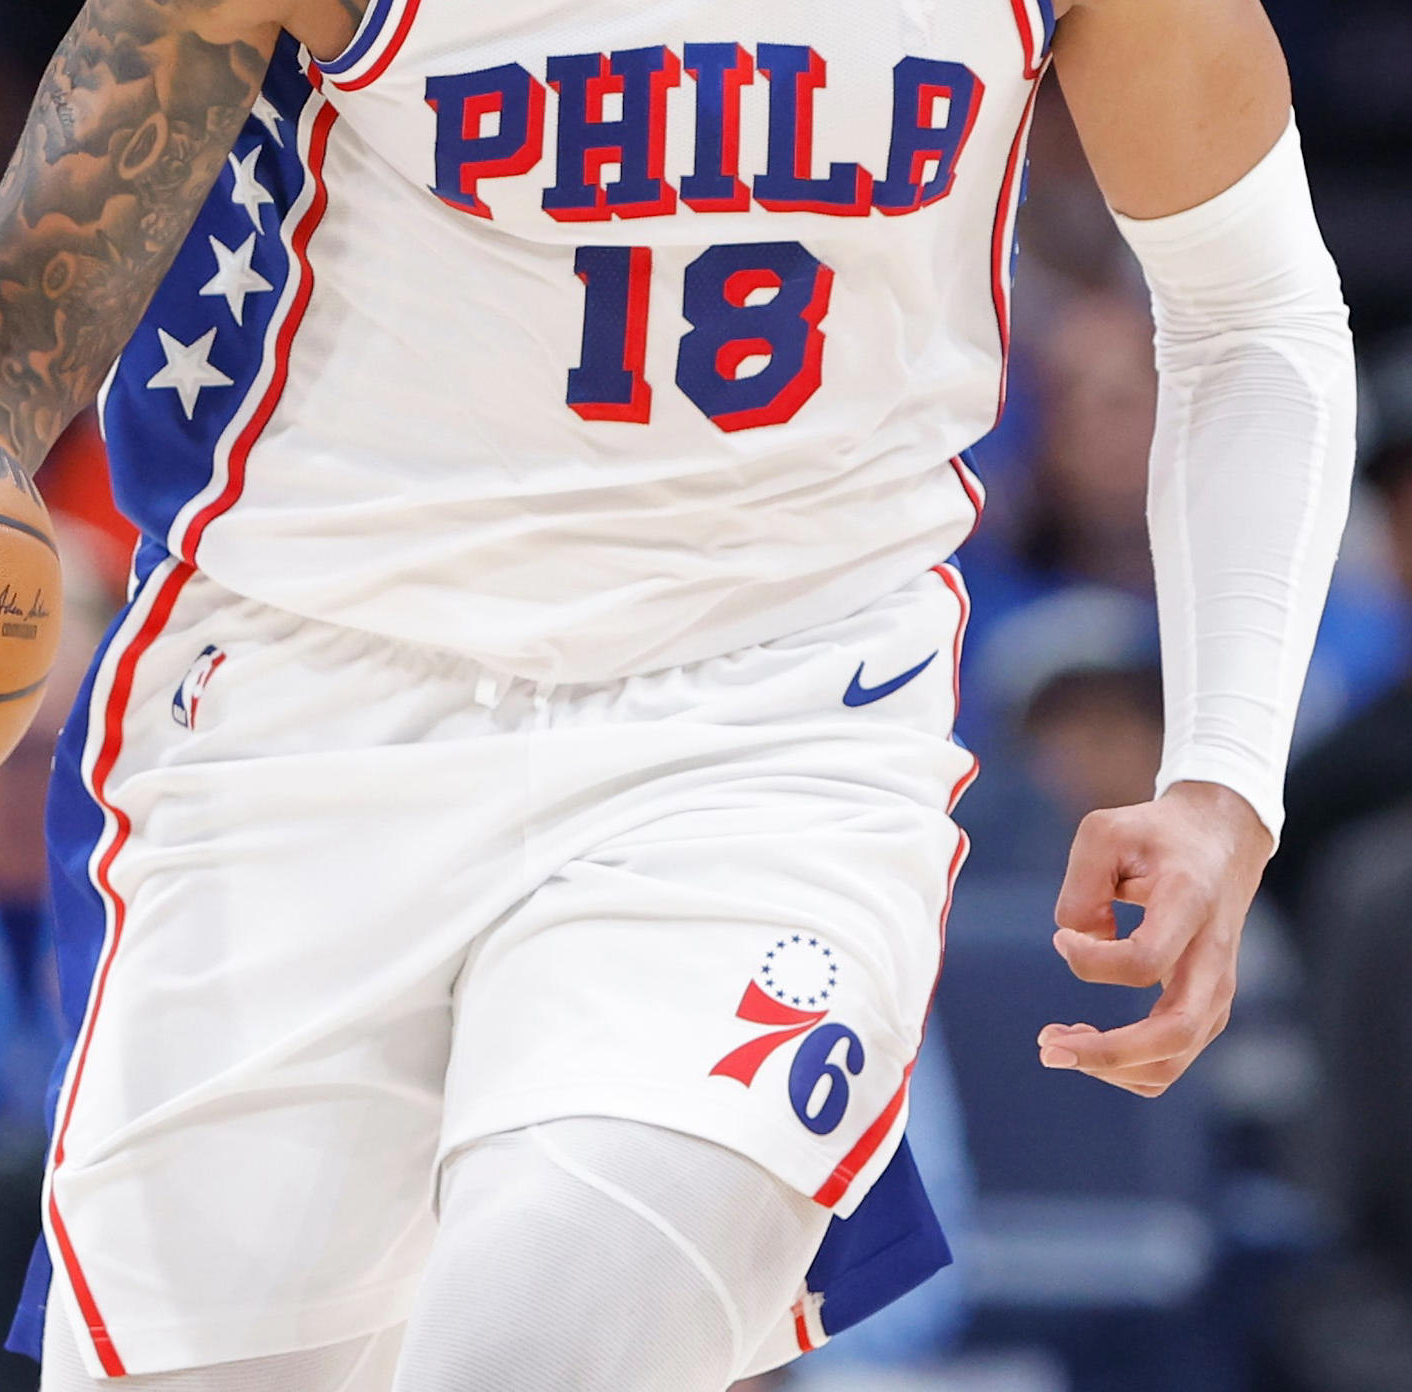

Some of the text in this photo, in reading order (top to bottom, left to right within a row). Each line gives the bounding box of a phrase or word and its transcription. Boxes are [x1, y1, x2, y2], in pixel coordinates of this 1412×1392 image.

[425, 41, 985, 222] PHILA
[566, 240, 836, 433] 18
[707, 979, 866, 1137] 76
